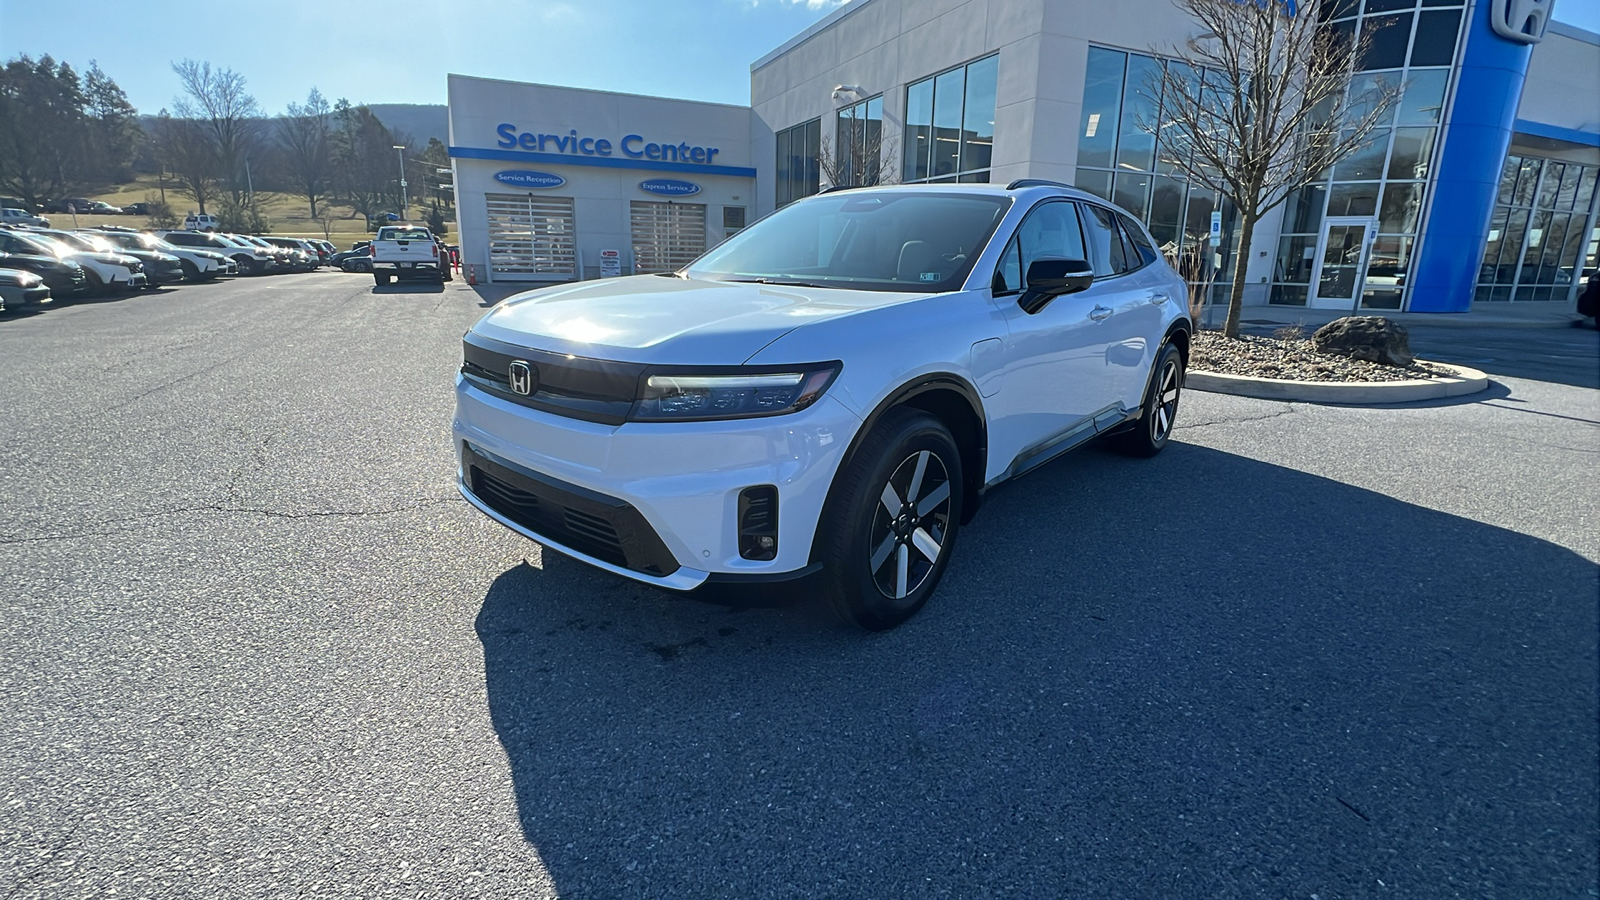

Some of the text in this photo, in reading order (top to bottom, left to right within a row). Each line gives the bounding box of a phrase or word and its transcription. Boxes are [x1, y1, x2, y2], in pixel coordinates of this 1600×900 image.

[496, 123, 719, 164] Service Center
[498, 173, 561, 184] Service Reception
[642, 183, 689, 192] Express Service
